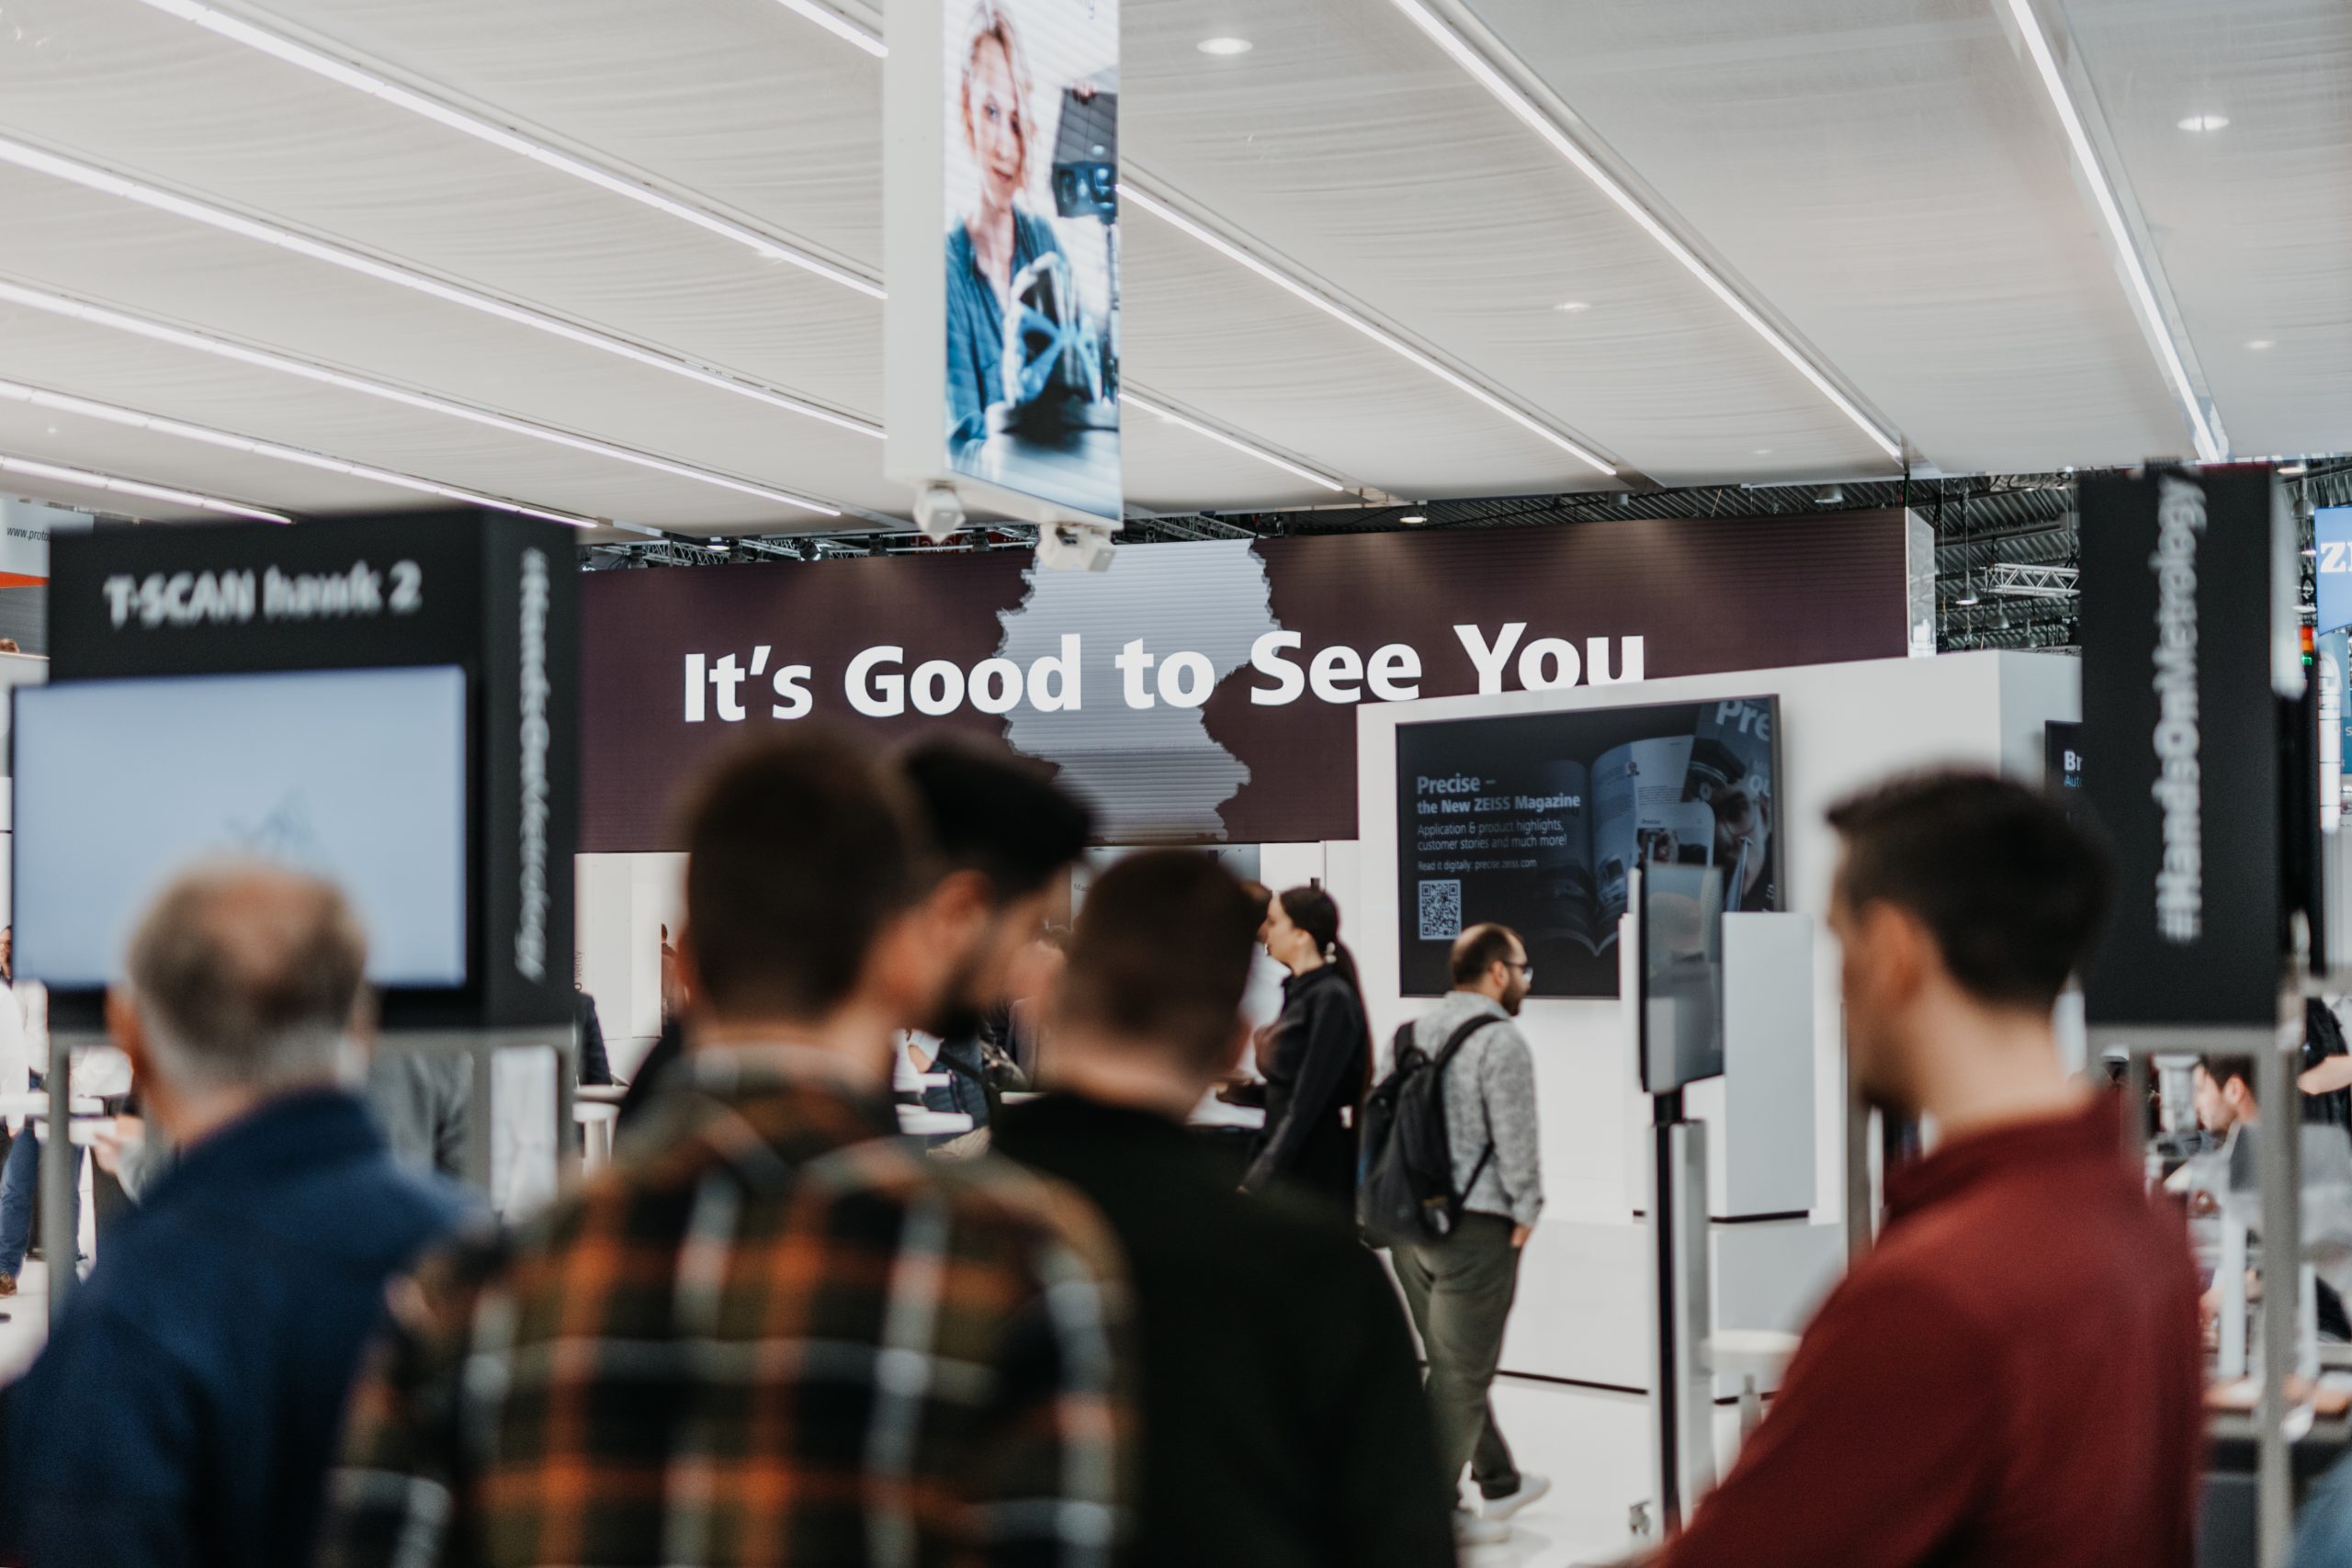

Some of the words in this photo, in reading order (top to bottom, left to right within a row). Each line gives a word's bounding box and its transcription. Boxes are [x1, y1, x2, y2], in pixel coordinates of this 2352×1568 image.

[2320, 542, 2352, 573] Z
[102, 571, 256, 629] T-SCAN
[390, 559, 423, 615] 2
[845, 633, 1081, 716] Good
[1114, 637, 1216, 709] to
[1250, 630, 1421, 705] See
[1454, 623, 1644, 698] You
[1417, 773, 1481, 795] Precise
[1417, 799, 1438, 815] the
[1441, 798, 1471, 814] New
[1474, 796, 1510, 812] ZEISS
[1514, 793, 1581, 813] Magazine
[1418, 822, 1466, 838] Application
[1468, 821, 1476, 834] &
[1478, 820, 1514, 835] product
[1517, 818, 1565, 834] highlights,
[1418, 839, 1458, 852] customer
[1460, 837, 1489, 850] stories
[1491, 836, 1509, 849] and
[1511, 835, 1538, 848] much
[1540, 833, 1567, 846] more!
[1418, 861, 1436, 871] Read
